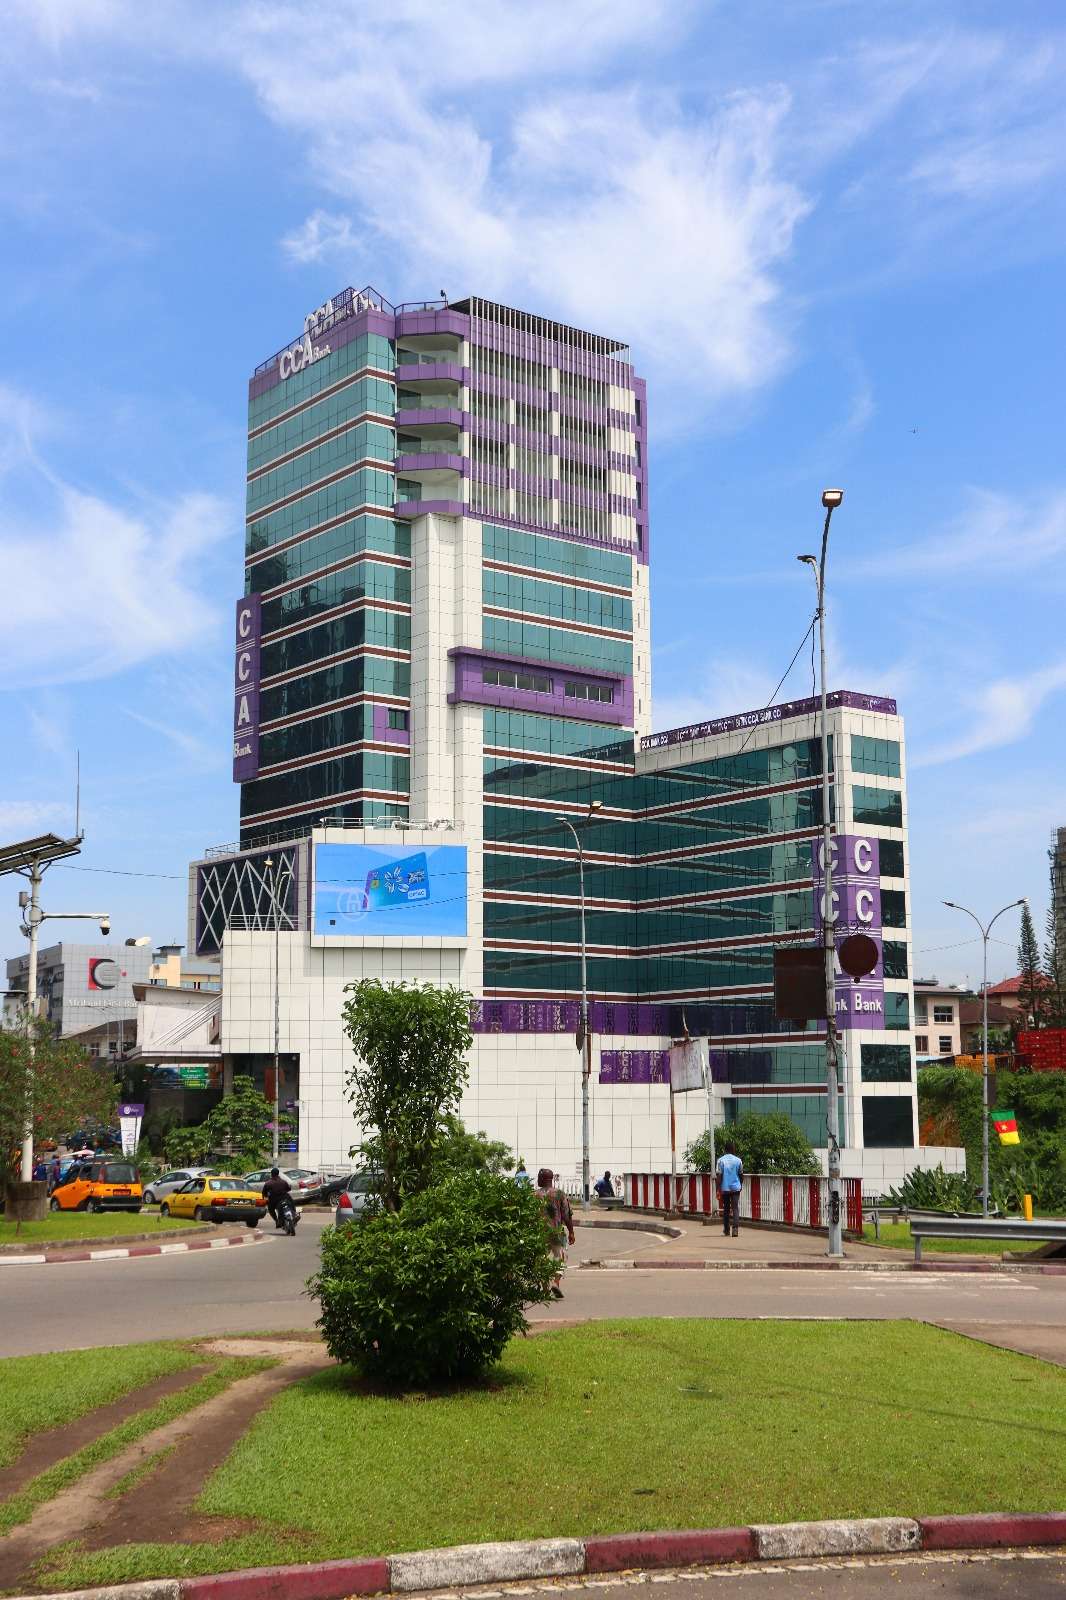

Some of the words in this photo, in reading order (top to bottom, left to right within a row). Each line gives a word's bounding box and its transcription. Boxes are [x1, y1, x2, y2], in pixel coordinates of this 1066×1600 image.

[279, 334, 313, 380] CCA
[313, 344, 331, 361] Bank
[233, 743, 252, 758] Bank
[835, 998, 848, 1011] nk
[855, 993, 882, 1012] Bank
